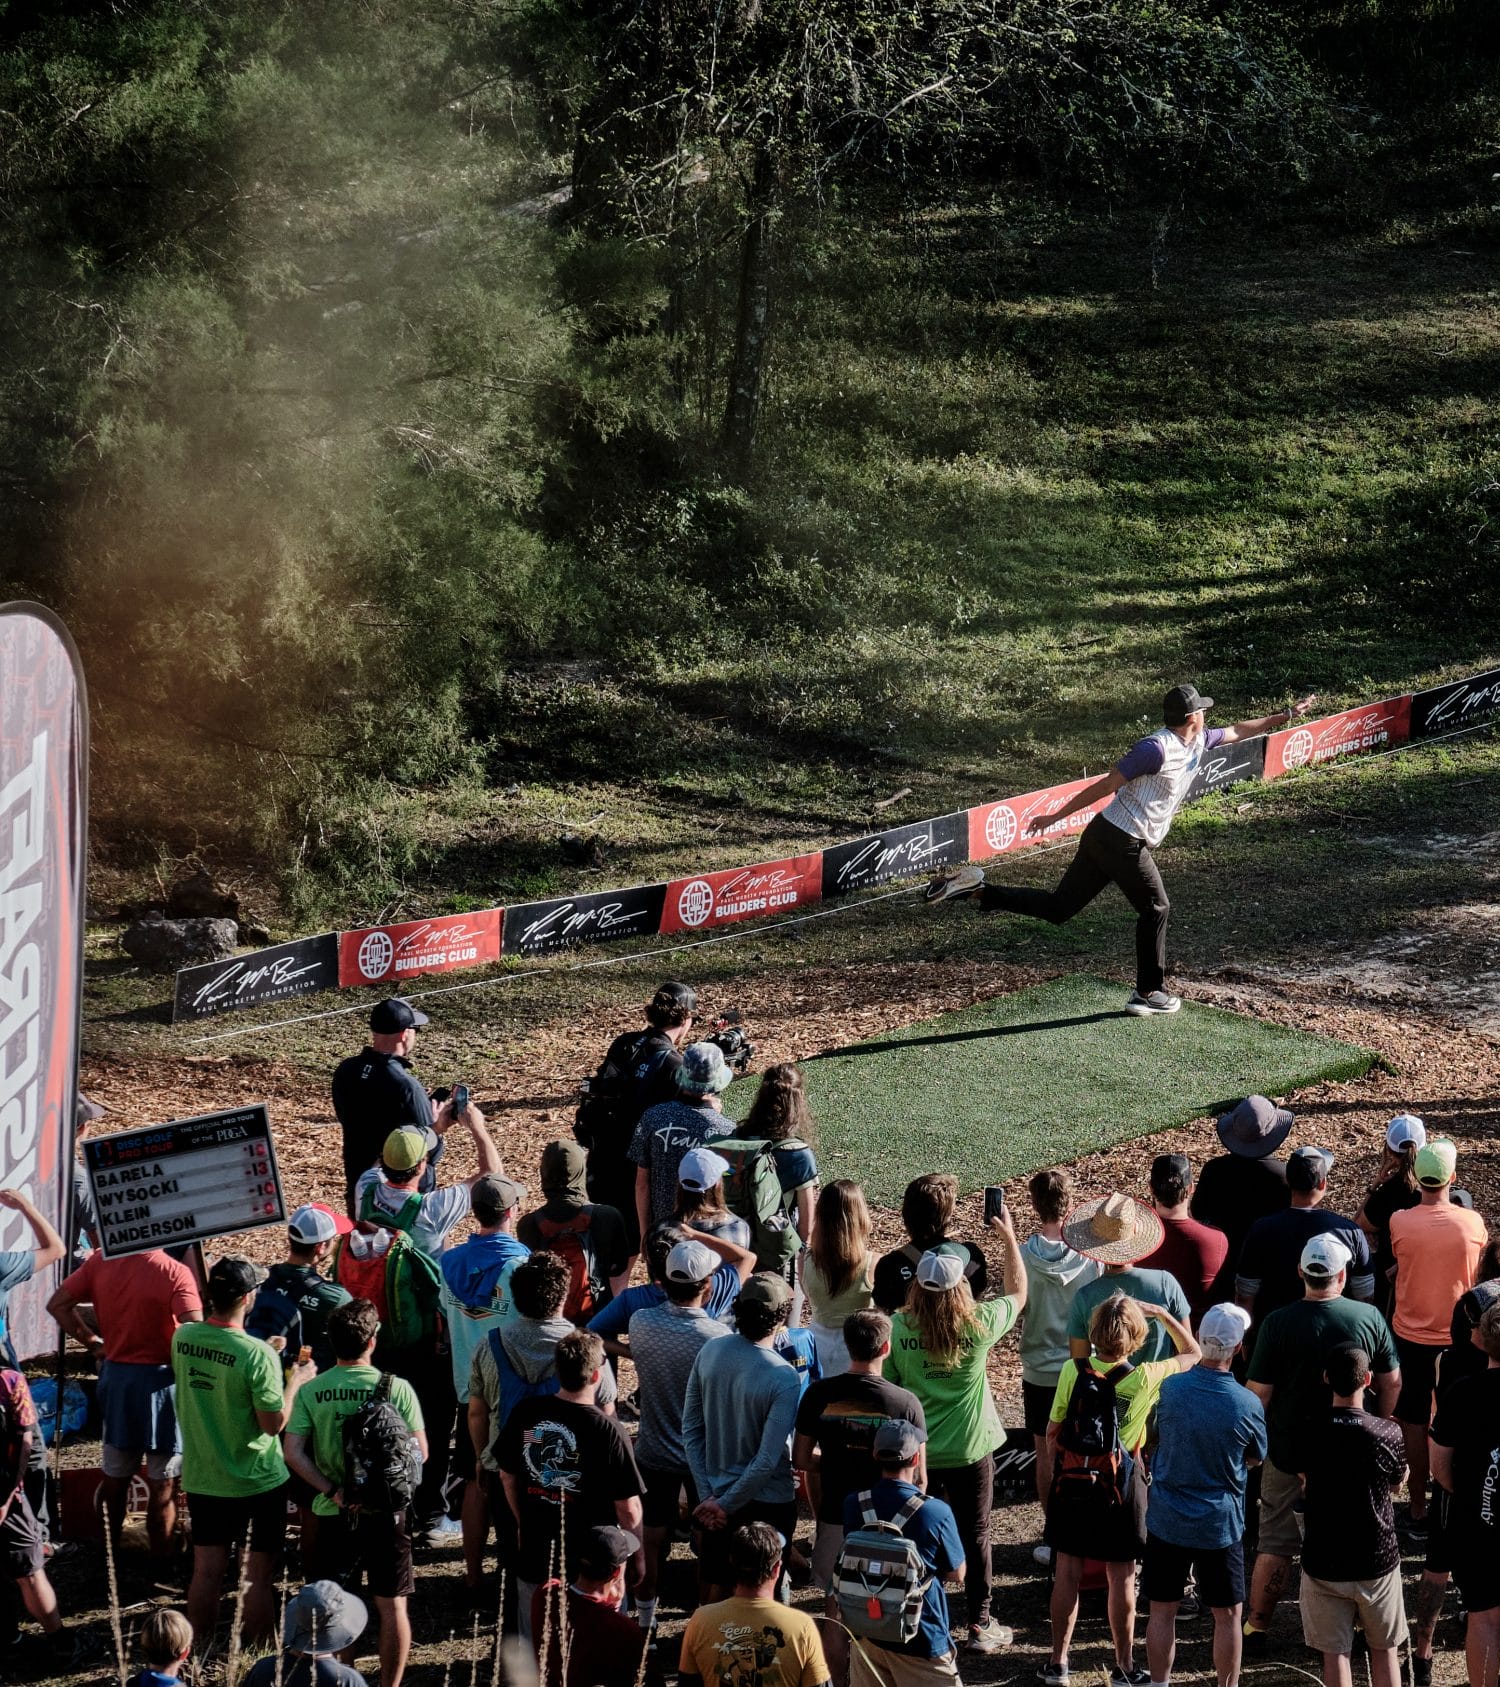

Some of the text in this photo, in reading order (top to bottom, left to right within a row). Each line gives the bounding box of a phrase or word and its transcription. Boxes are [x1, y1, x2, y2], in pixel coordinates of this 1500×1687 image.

[1314, 731, 1388, 761] BUILDERS CLUB
[1020, 819, 1068, 841] BDERS
[715, 891, 798, 918] BUILDERS CLUB
[395, 948, 478, 972] BUILDERS CLUB
[196, 1003, 218, 1014] PAUL
[237, 1113, 255, 1121] TOUR
[116, 1131, 174, 1151] DISC GOLF
[216, 1126, 249, 1142] PDGA
[144, 1141, 174, 1153] TOUR
[96, 1163, 164, 1189] BARELA
[98, 1179, 179, 1208] WYSOCKI
[101, 1205, 150, 1227] KLEIN
[107, 1215, 196, 1247] ANDERSON
[176, 1341, 237, 1368] VOLUNTEER
[315, 1388, 375, 1404] VOLUNTE
